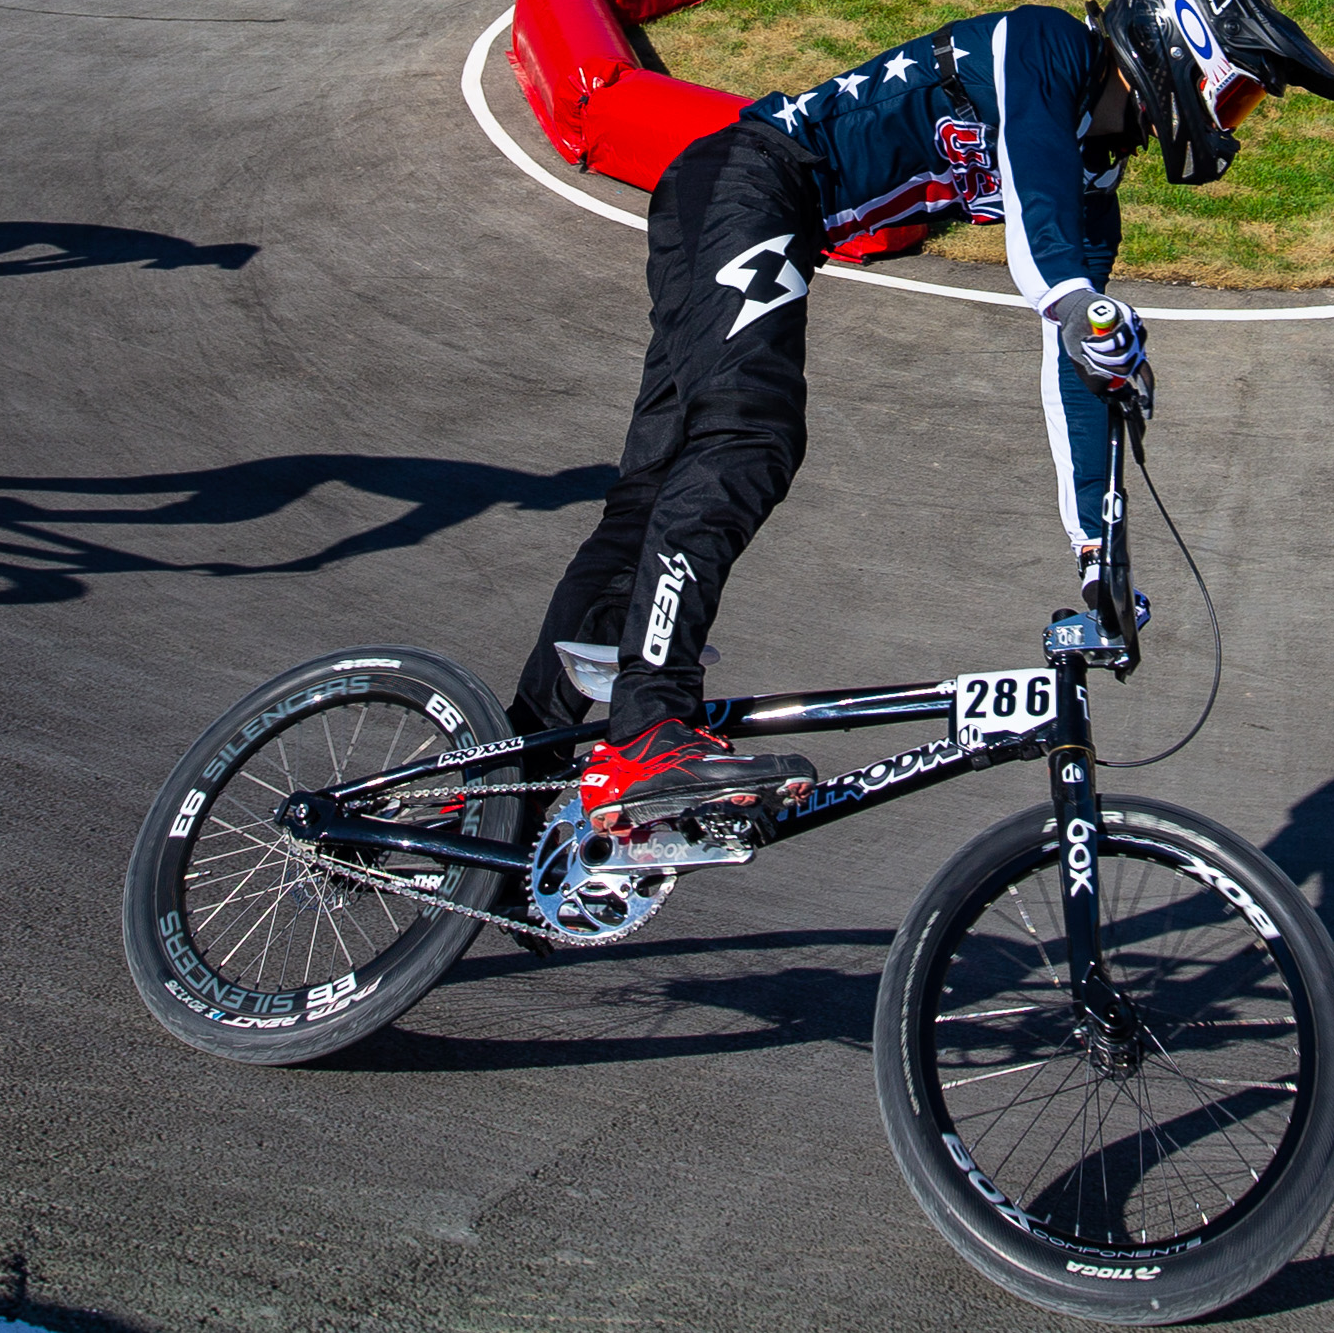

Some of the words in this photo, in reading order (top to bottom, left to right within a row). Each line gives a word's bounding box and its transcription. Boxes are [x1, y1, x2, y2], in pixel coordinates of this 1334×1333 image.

[425, 693, 465, 733] E6
[964, 675, 1051, 719] 286
[169, 788, 206, 838] E6
[203, 676, 371, 782] SILENCERS
[438, 746, 479, 767] PRO
[1067, 818, 1097, 897] box
[1178, 856, 1281, 939] BOX
[160, 911, 296, 1013] SILENCERS
[306, 972, 357, 1009] E6
[220, 1014, 301, 1028] REACT
[942, 1133, 1048, 1231] BOX
[1033, 1229, 1202, 1258] COMPONENTS
[1067, 1260, 1133, 1280] TIOGA
